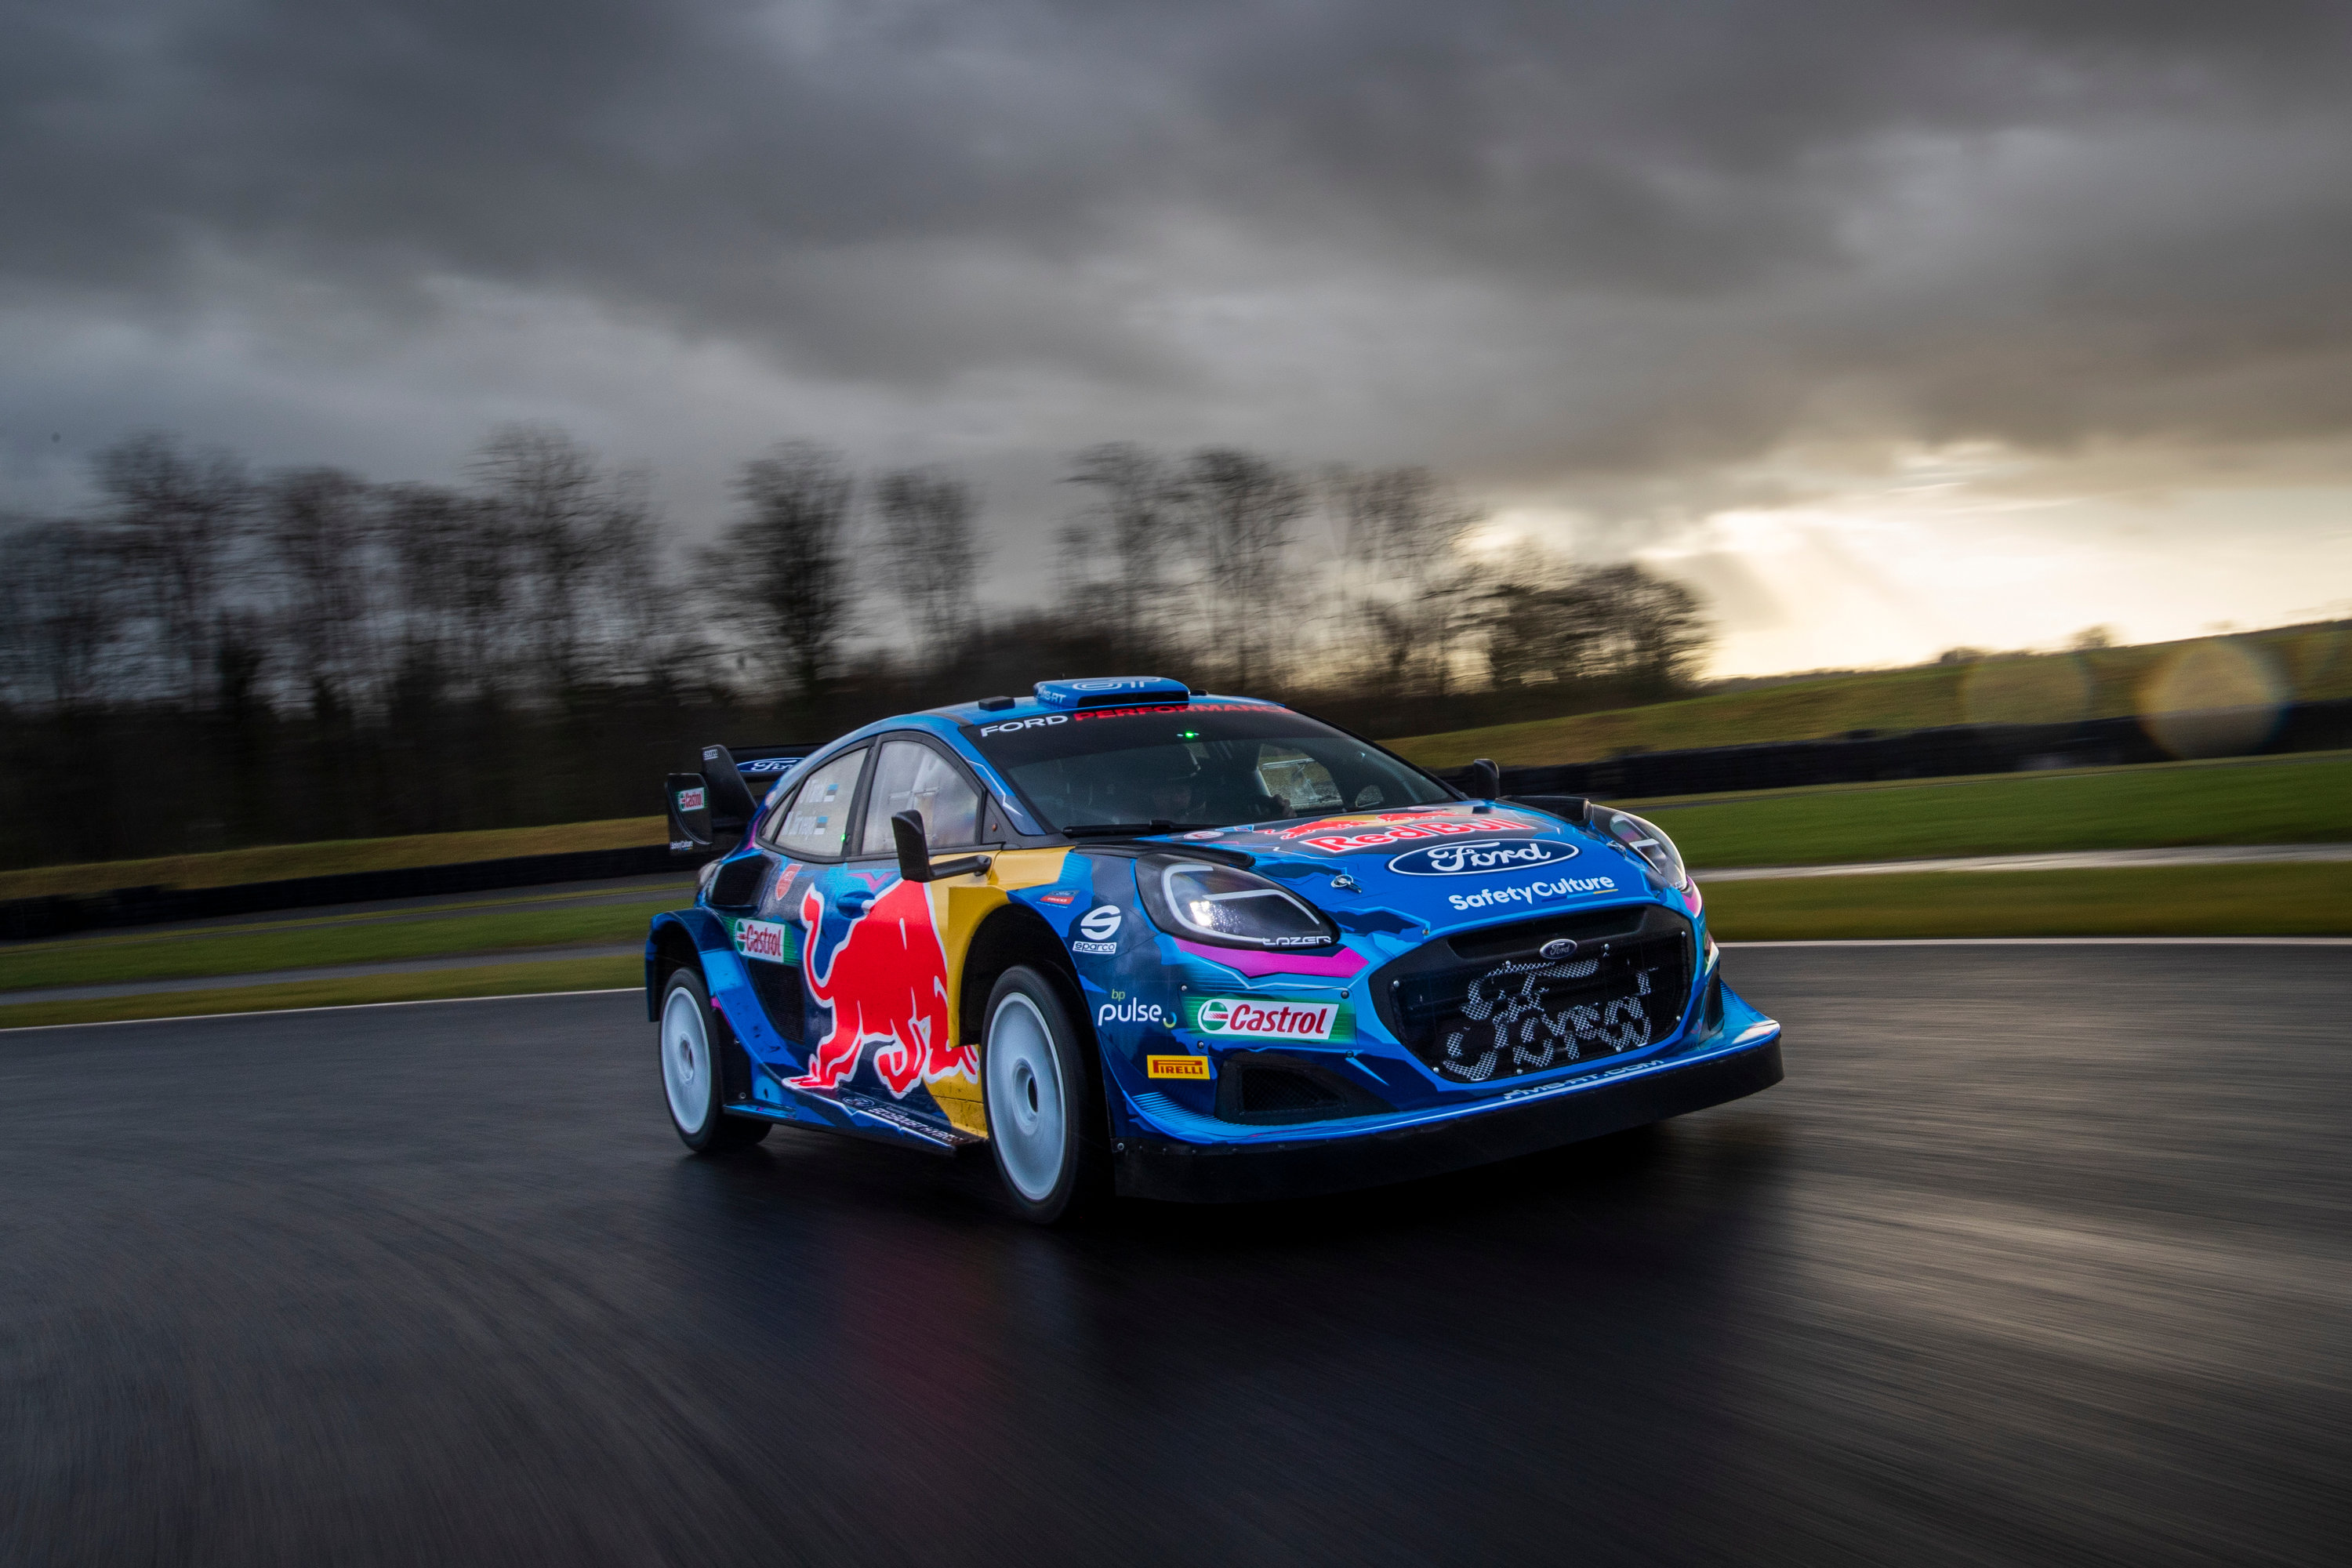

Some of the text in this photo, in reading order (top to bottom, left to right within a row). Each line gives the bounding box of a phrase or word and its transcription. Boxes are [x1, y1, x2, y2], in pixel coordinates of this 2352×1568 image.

[981, 715, 1069, 737] FORD
[1427, 841, 1552, 872] Ford
[1448, 875, 1615, 910] SafetyCulture
[746, 924, 782, 956] Castrol
[1076, 942, 1115, 951] sparco
[1262, 936, 1331, 946] LAZER
[1549, 942, 1570, 956] Ford
[1111, 989, 1126, 1001] bp
[1098, 997, 1163, 1026] pulse
[1229, 1004, 1328, 1034] Castrol
[1152, 1060, 1203, 1075] PIRELLI
